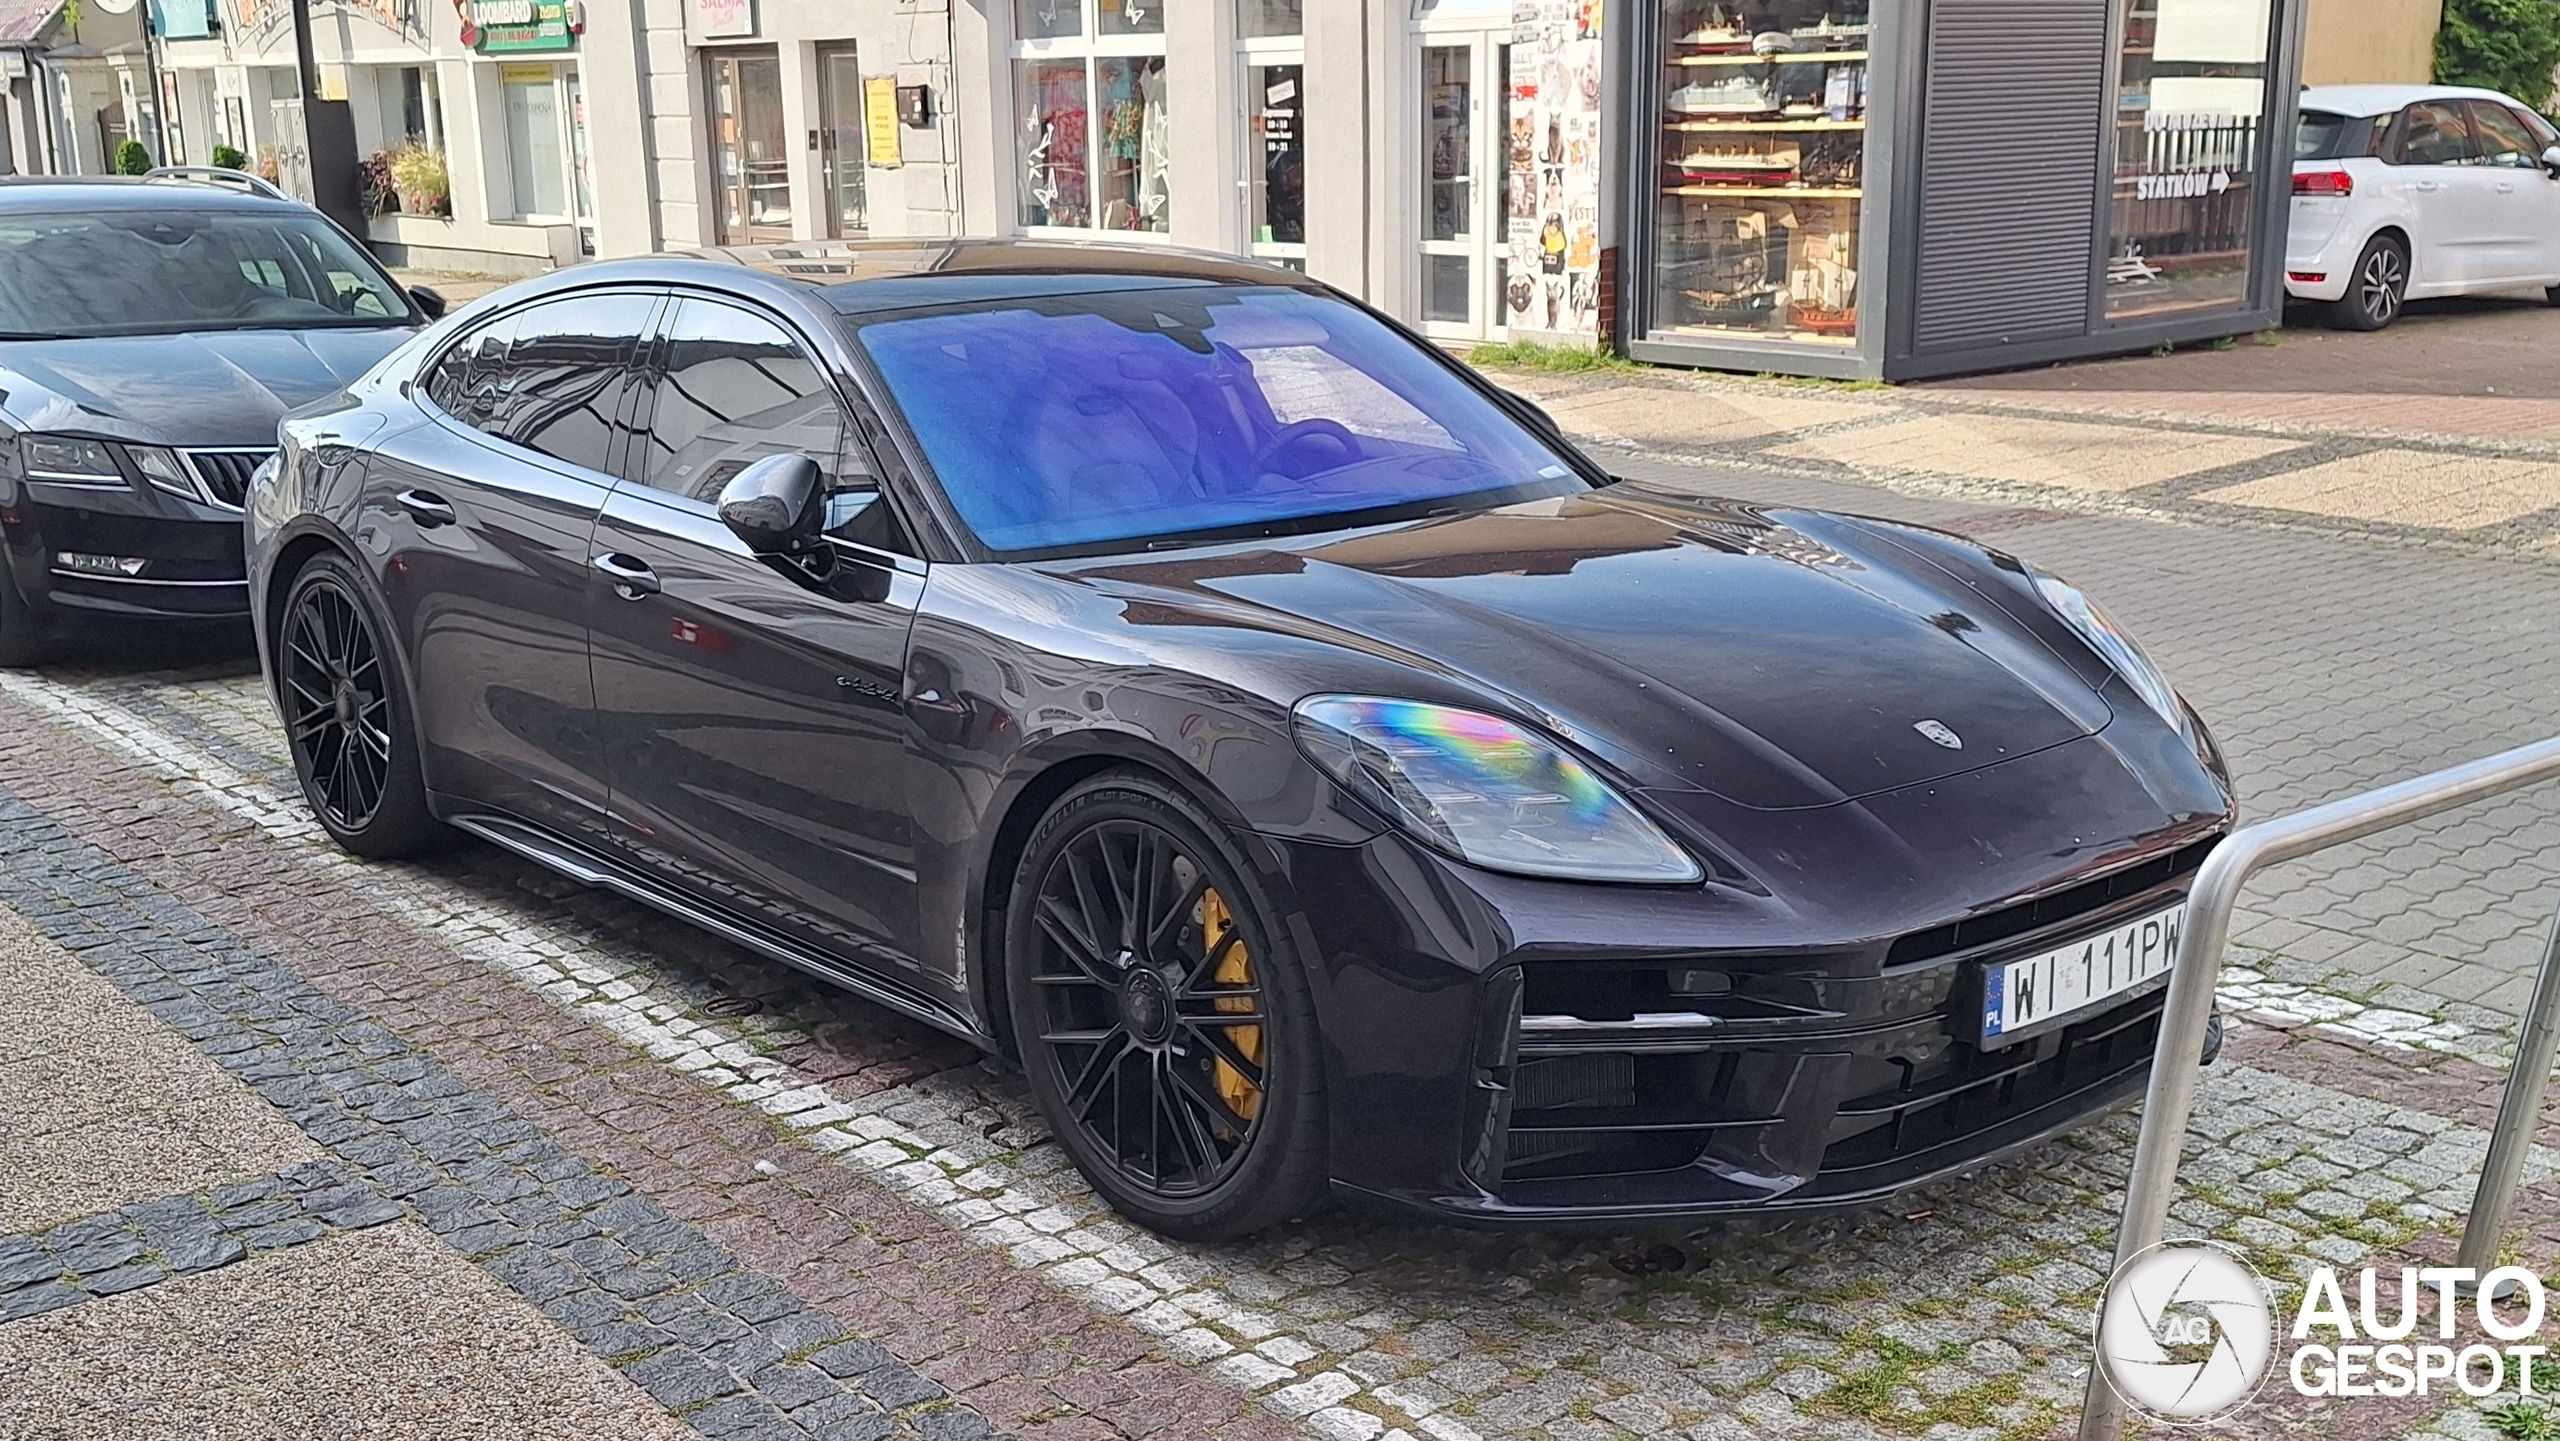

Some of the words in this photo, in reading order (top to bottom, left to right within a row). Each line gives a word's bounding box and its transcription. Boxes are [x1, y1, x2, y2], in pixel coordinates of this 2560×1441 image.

[473, 0, 532, 25] LOOMBARD
[2137, 167, 2209, 200] STATKÓW
[2015, 956, 2055, 1023] WI
[1986, 1011, 2000, 1028] PL
